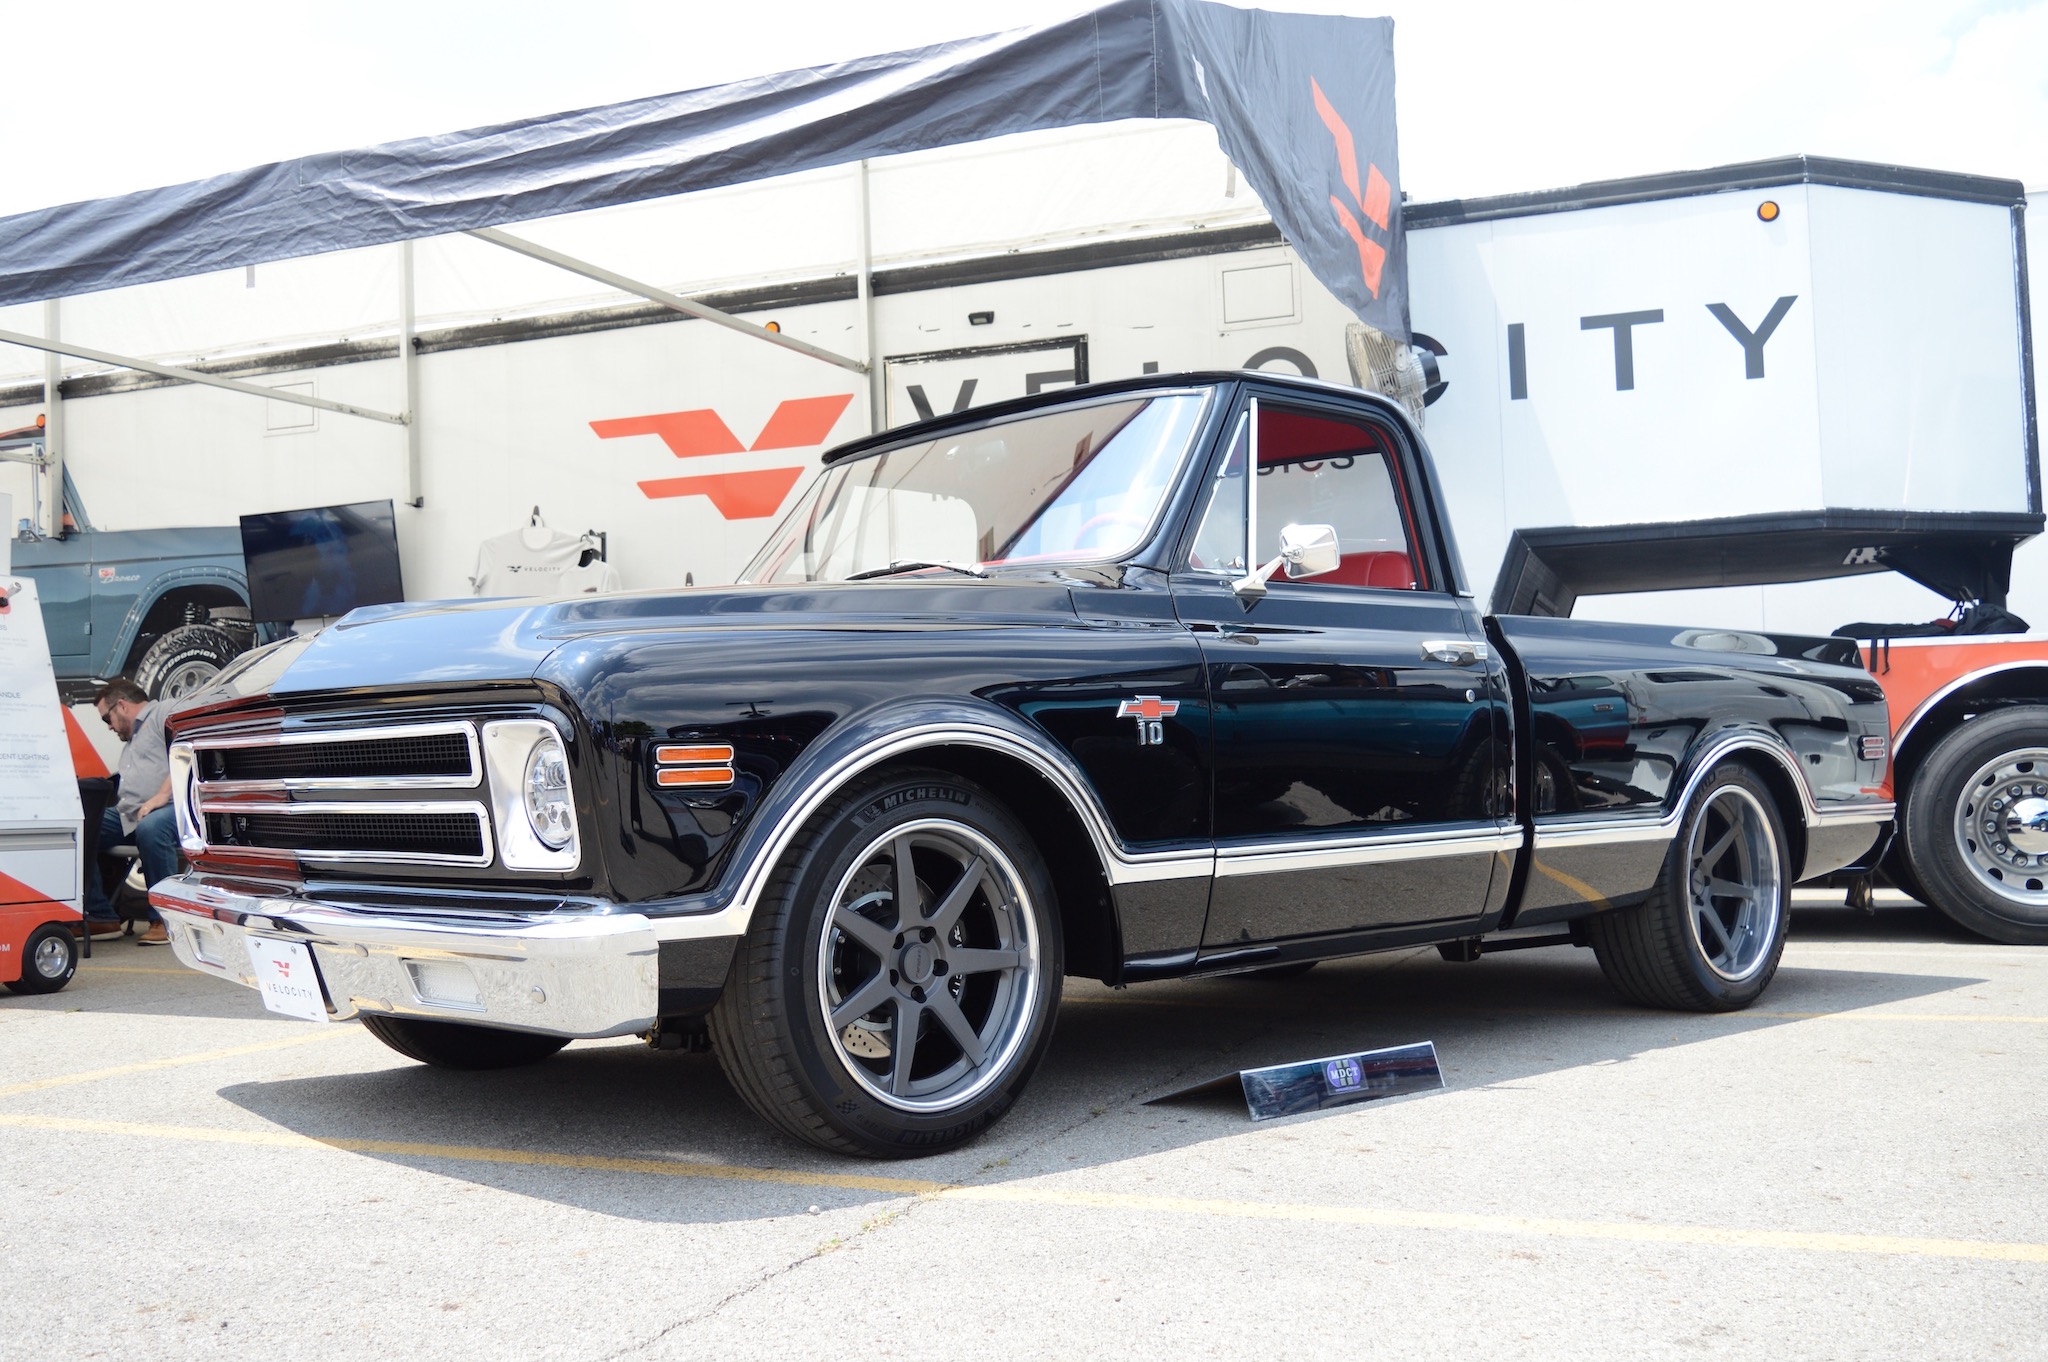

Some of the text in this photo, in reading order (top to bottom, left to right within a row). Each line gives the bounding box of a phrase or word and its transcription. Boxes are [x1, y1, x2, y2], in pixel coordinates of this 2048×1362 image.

[1137, 721, 1164, 745] 10
[17, 753, 50, 761] LIGHTING
[883, 787, 967, 810] MICHELIN
[266, 981, 313, 1000] VELOCITY
[1330, 1067, 1358, 1080] MDCT
